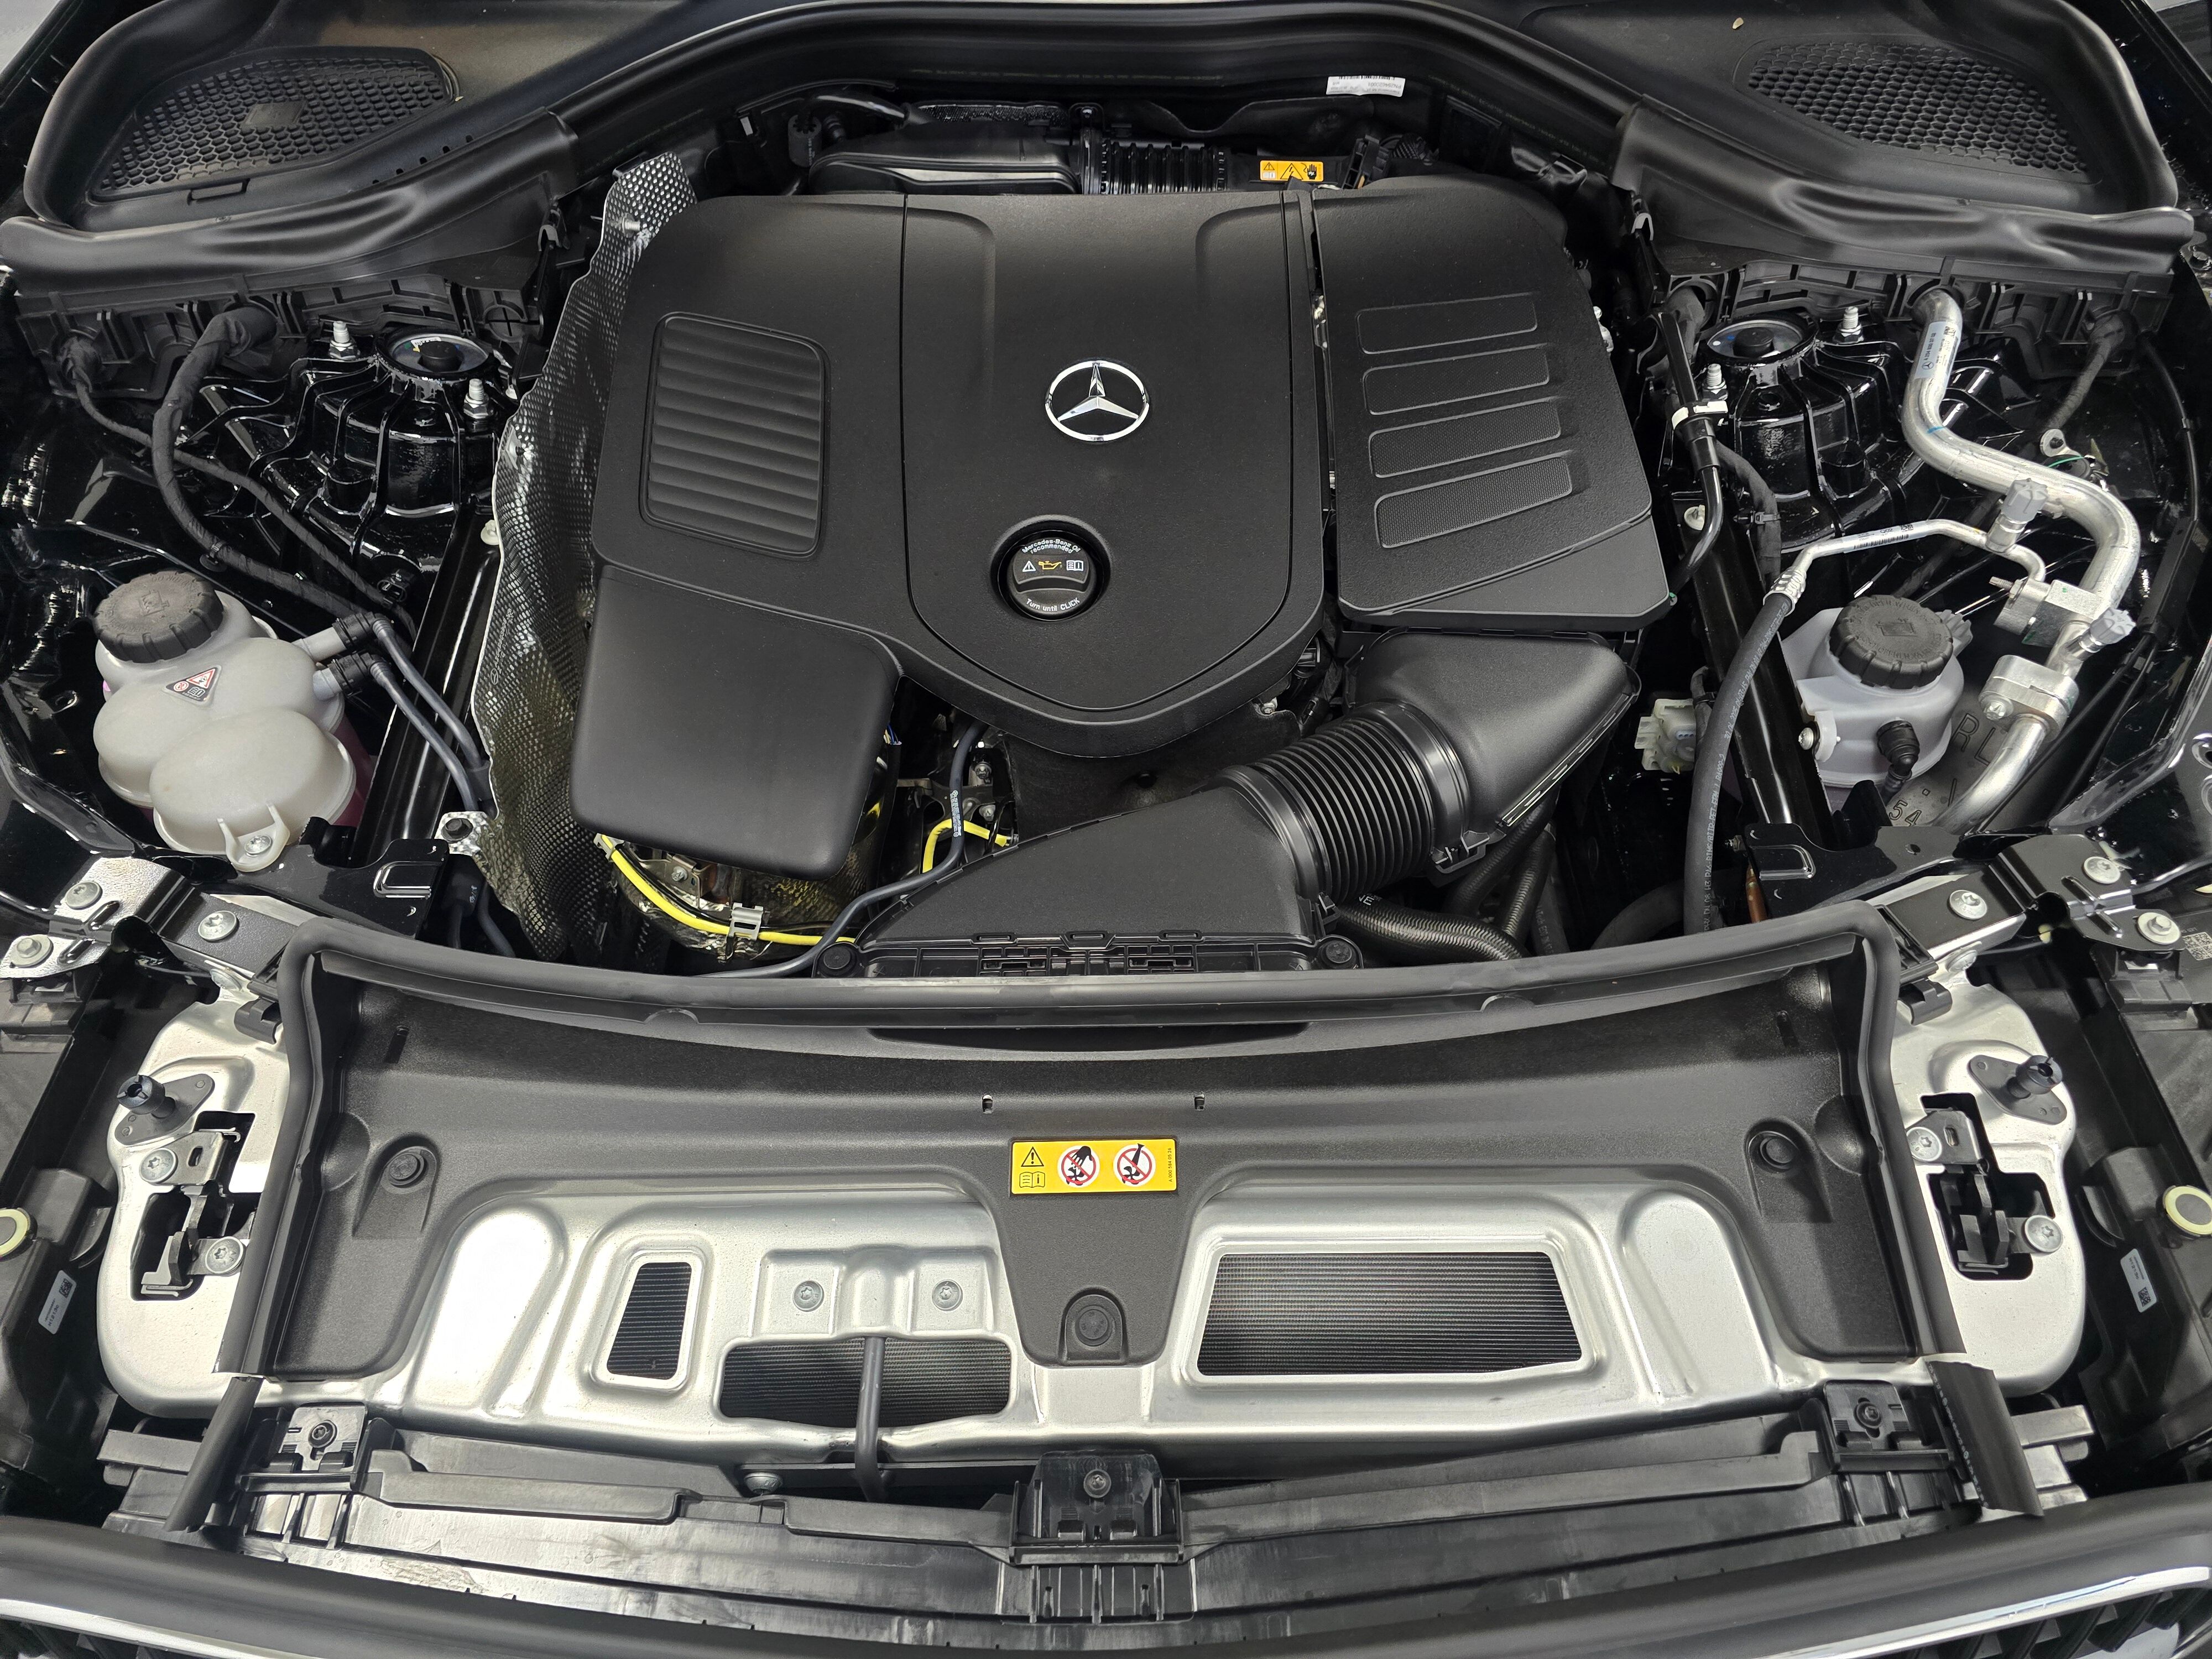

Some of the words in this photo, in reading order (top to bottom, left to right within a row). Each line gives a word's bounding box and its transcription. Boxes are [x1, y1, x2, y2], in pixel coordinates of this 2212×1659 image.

[1021, 539, 1072, 553] Mercedes-Benz
[1030, 544, 1074, 554] recommended
[1026, 598, 1040, 610] Turn
[1060, 597, 1081, 611] CLICK
